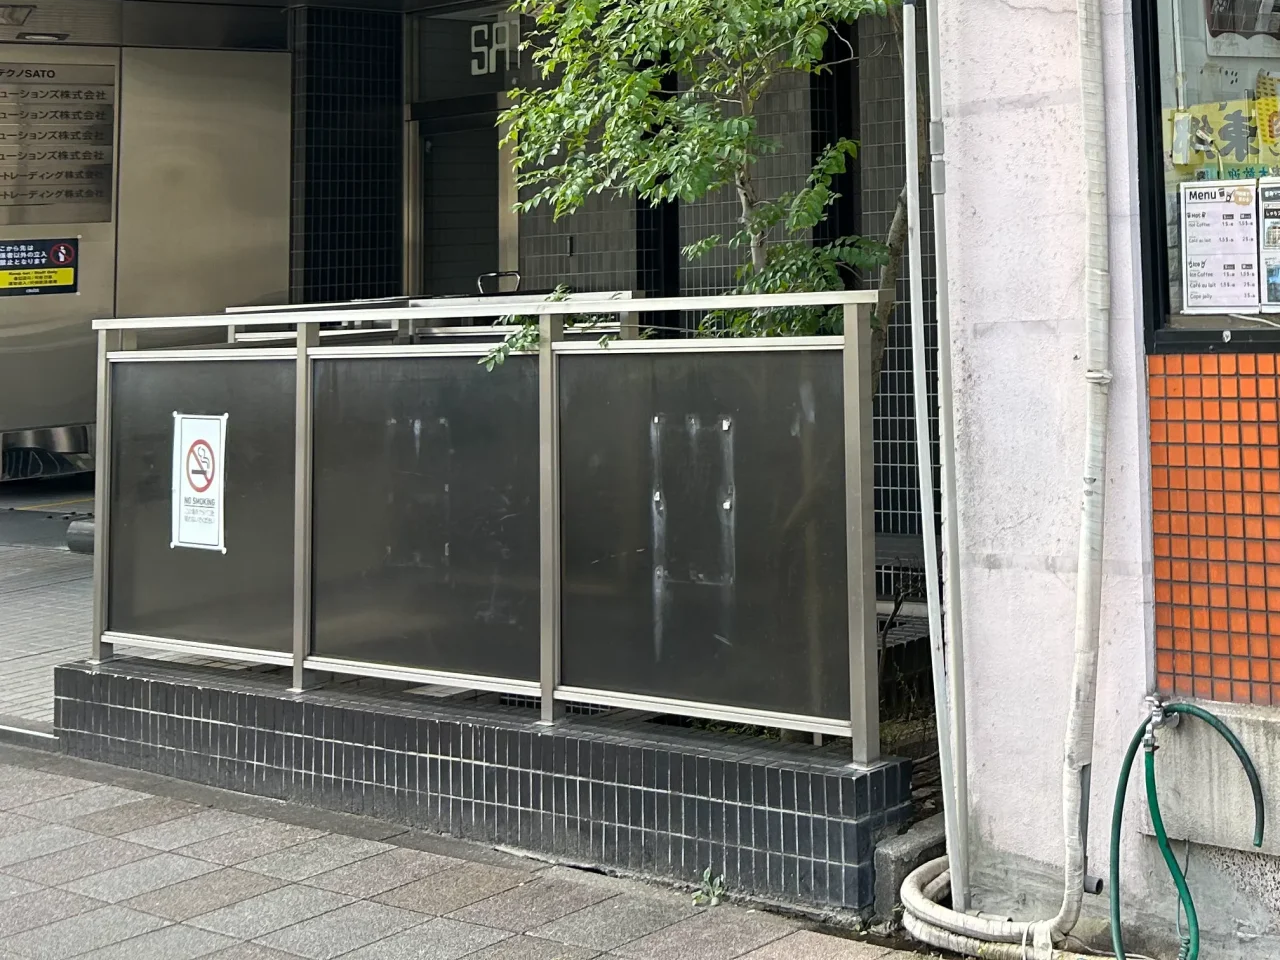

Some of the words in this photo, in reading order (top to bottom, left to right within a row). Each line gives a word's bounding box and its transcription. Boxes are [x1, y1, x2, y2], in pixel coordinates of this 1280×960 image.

[1188, 190, 1217, 201] Menu
[184, 496, 192, 505] NO
[192, 497, 216, 506] SMOKING
